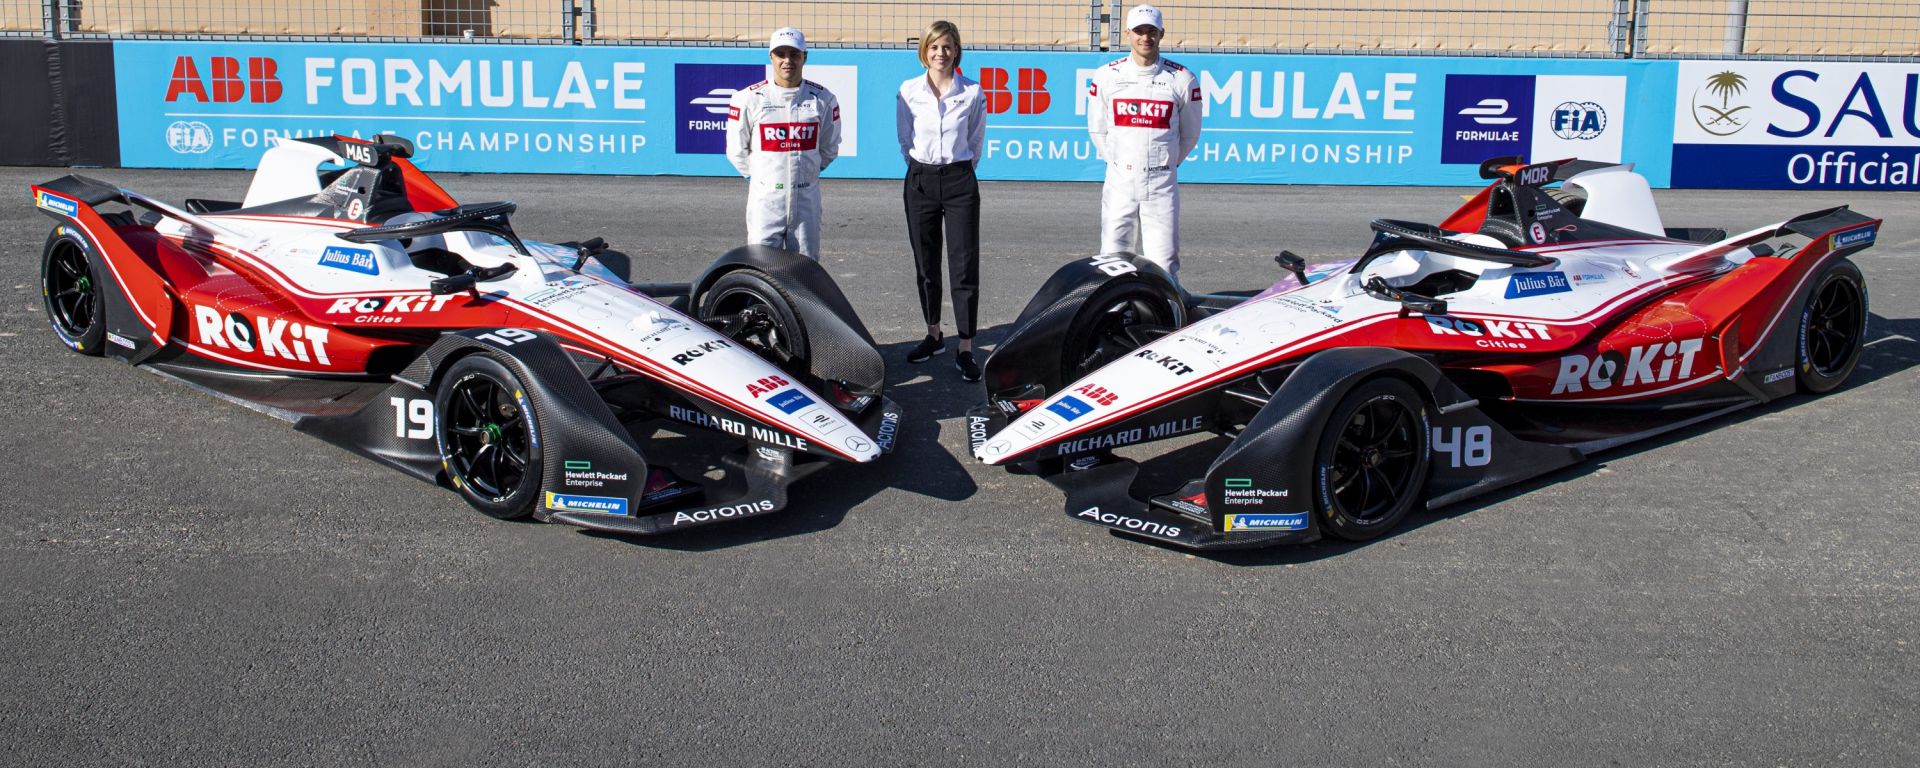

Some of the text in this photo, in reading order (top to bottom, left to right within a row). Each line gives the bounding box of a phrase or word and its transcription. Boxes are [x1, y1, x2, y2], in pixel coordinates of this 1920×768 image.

[165, 56, 646, 110] ABB FORMULA-E
[956, 67, 1417, 120] BB FMULA-E
[689, 121, 728, 131] FORMU
[416, 131, 646, 154] CHAMPIONSHIP
[1455, 131, 1519, 142] FORMULA-E
[345, 143, 371, 163] MAS
[988, 139, 1104, 160] FORMU
[1520, 166, 1550, 186] MOR
[1787, 152, 1920, 185] Official
[351, 203, 360, 216] E
[1533, 226, 1542, 241] E
[322, 251, 350, 266] Julius
[1514, 275, 1566, 294] Julius Bär
[354, 314, 402, 324] Cities
[475, 328, 538, 347] 19
[1475, 339, 1527, 350] Cities
[745, 375, 790, 399] ABB
[1073, 383, 1119, 406] ABB
[390, 396, 435, 441] 19
[670, 404, 808, 451] RICHARD MILLE
[1057, 415, 1204, 456] RICHARD MILLE
[1432, 424, 1493, 468] 48
[565, 470, 628, 481] Hewlett Packard
[565, 478, 604, 488] Enterprise
[1224, 497, 1264, 506] Enterprise
[1225, 488, 1289, 498] Hewlett Packard
[567, 499, 621, 510] MICHELIN
[672, 499, 775, 527] Acronis
[1077, 506, 1182, 538] Acronis
[1248, 517, 1304, 528] MICHELIN
